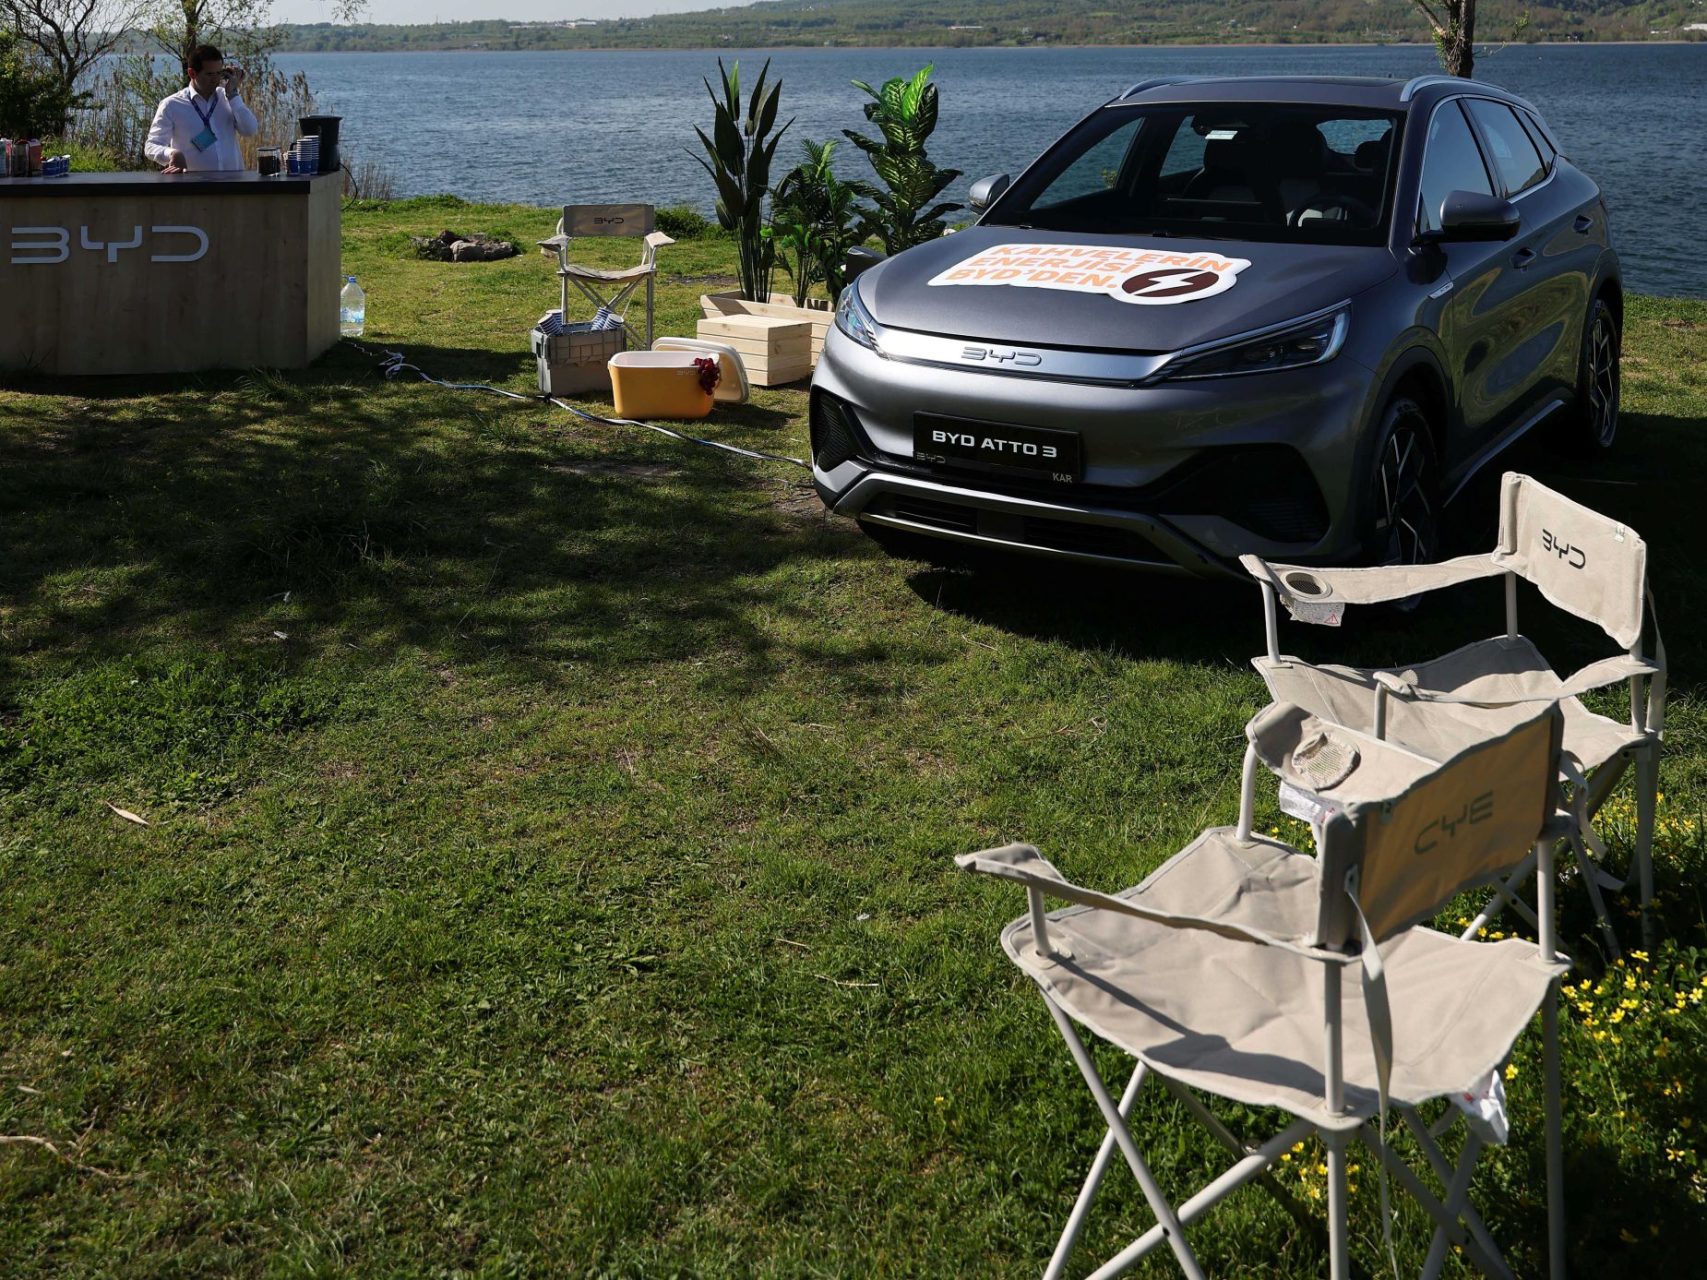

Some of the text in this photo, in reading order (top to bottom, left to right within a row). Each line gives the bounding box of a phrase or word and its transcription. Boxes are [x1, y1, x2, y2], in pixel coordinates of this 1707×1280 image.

[11, 225, 209, 264] BYD
[990, 246, 1233, 271] KAHVELERİN
[961, 346, 1042, 366] BYD
[932, 430, 1057, 458] BYD ATTO 3
[916, 452, 946, 464] BYD
[1052, 472, 1073, 483] KAR
[1542, 528, 1586, 570] BYD
